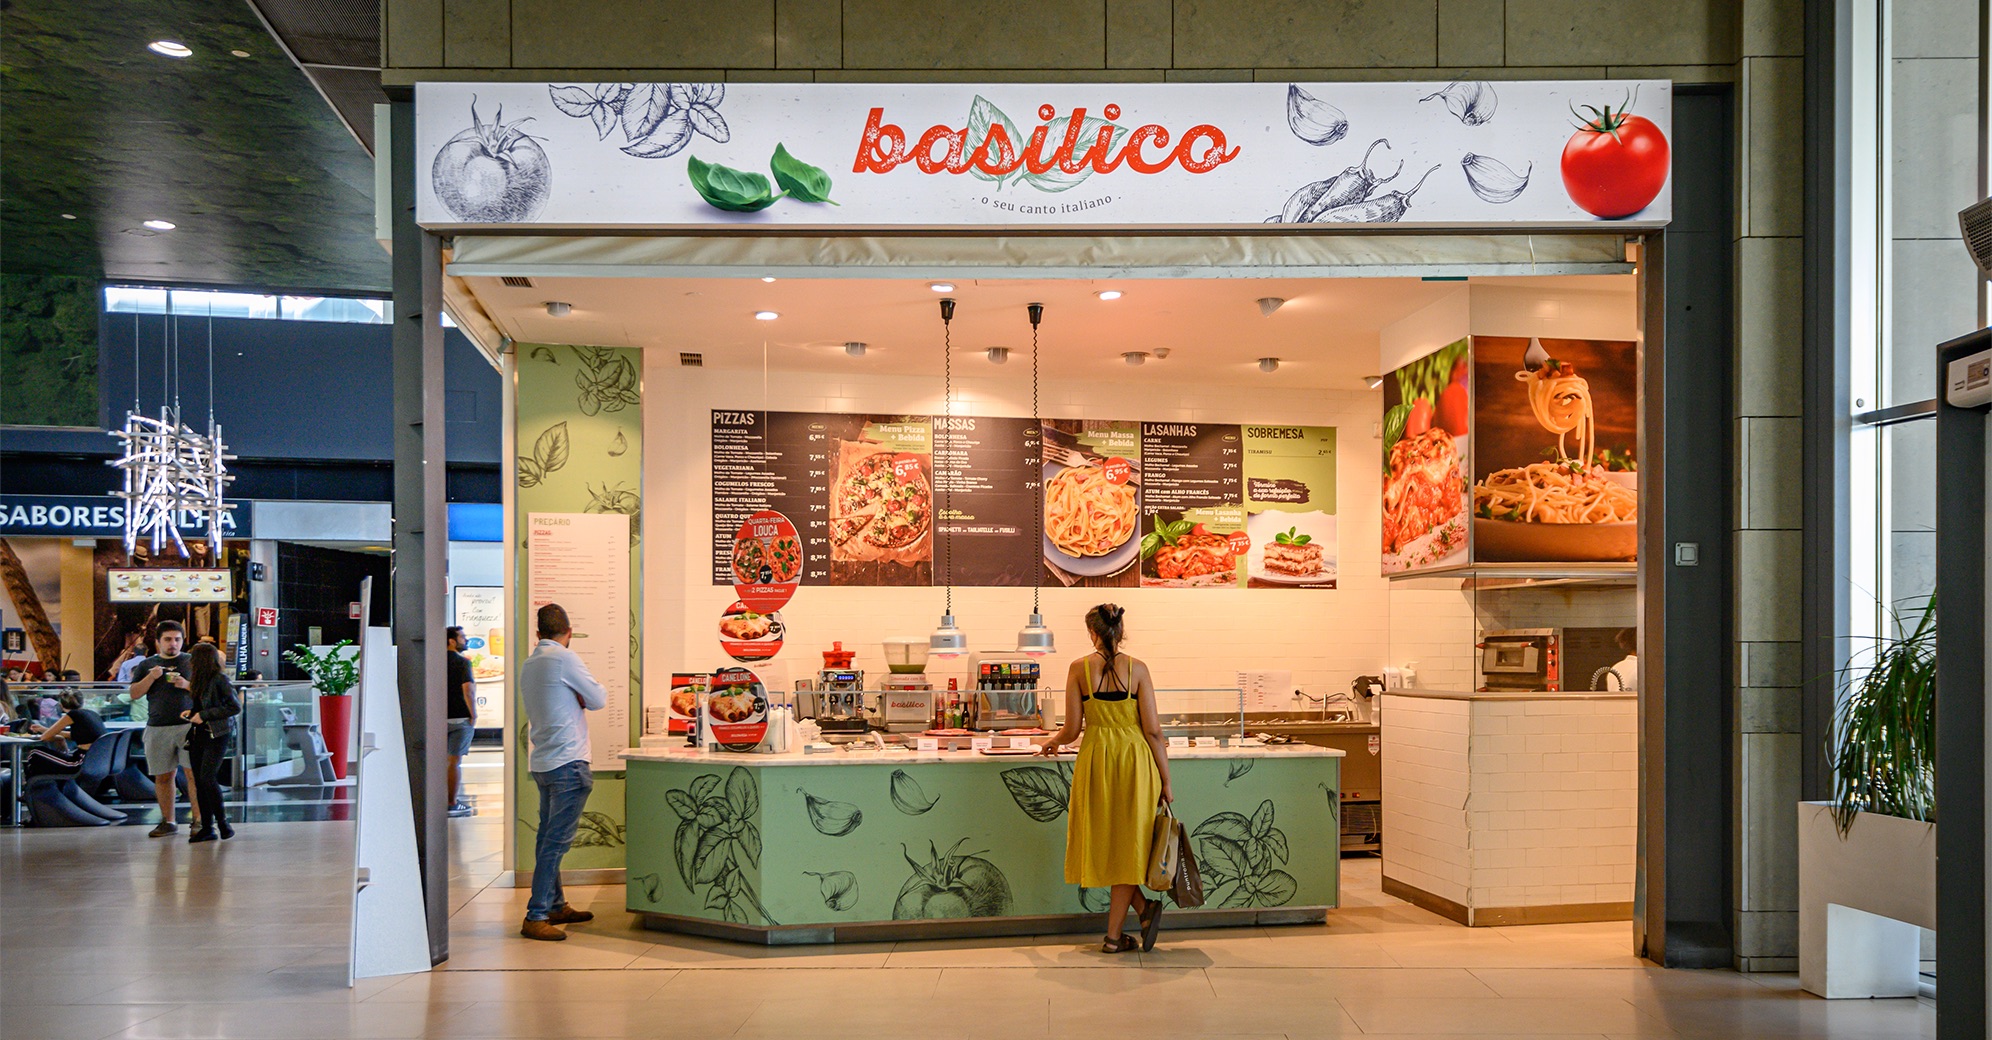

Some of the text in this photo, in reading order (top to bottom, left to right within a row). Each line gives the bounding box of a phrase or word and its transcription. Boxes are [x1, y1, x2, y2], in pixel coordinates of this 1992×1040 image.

[852, 103, 1241, 174] basilico
[981, 195, 1112, 214] o seu canto italiano
[713, 412, 755, 425] PIZZAS
[934, 418, 976, 431] MASSAS
[1144, 424, 1197, 437] LASANHAS
[1247, 427, 1304, 439] SOBREMESA
[0, 505, 125, 529] SABORES
[753, 525, 779, 537] LOUCA
[239, 645, 248, 662] ILHA
[722, 673, 752, 682] CANELONE
[891, 701, 925, 709] basilico
